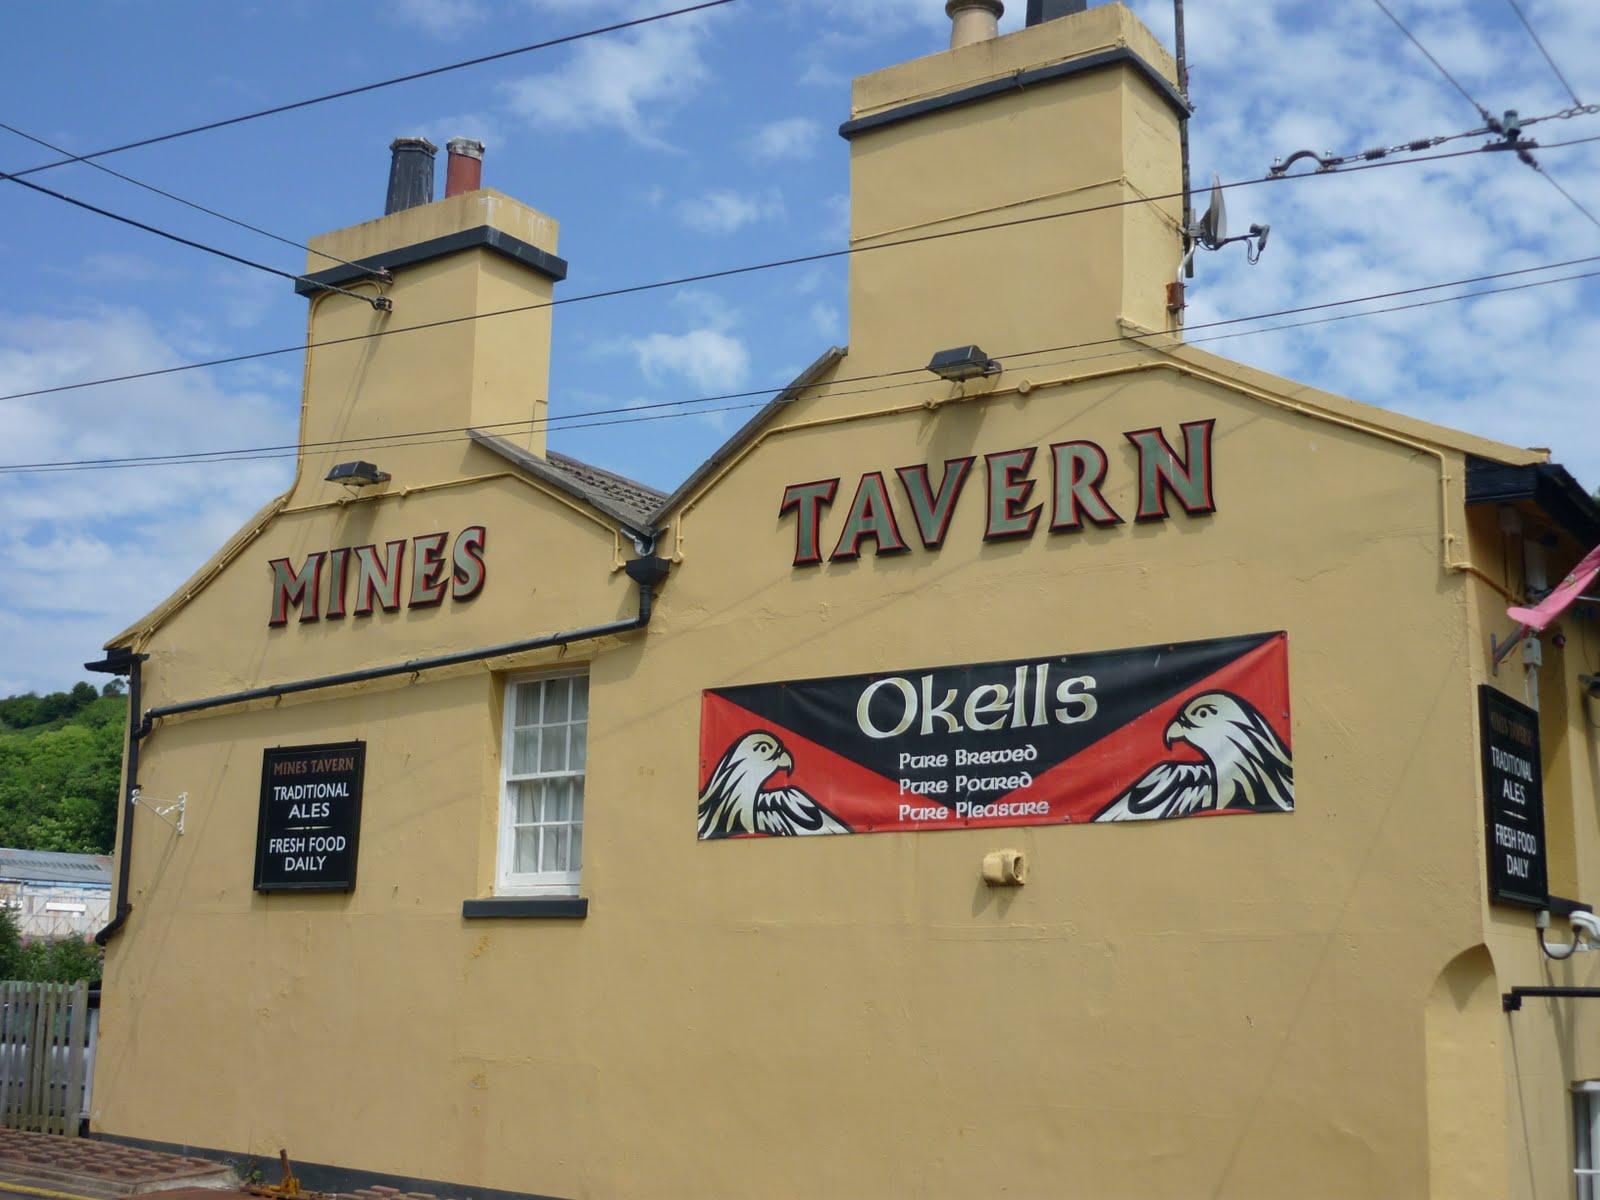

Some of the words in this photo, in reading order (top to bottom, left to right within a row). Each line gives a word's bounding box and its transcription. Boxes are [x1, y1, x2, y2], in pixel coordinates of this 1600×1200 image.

[779, 418, 1217, 567] TAVERN
[268, 526, 486, 627] MINES
[856, 663, 1098, 739] Okells
[955, 744, 1038, 766] Brewed
[1491, 746, 1533, 782] TRADITIONAL
[273, 760, 307, 776] MINES
[311, 757, 354, 773] TAVERN
[273, 782, 350, 801] TRADITIONAL
[955, 771, 1033, 792] Poured
[1502, 778, 1525, 805] ALES
[288, 802, 330, 819] ALES
[955, 800, 1050, 819] Pleasure
[269, 837, 306, 854] FRESH
[309, 835, 346, 852] FOOD
[1495, 823, 1516, 848] FRESH
[1517, 830, 1537, 856] FOOD
[284, 855, 327, 871] DAILY
[1506, 854, 1529, 878] DAILY
